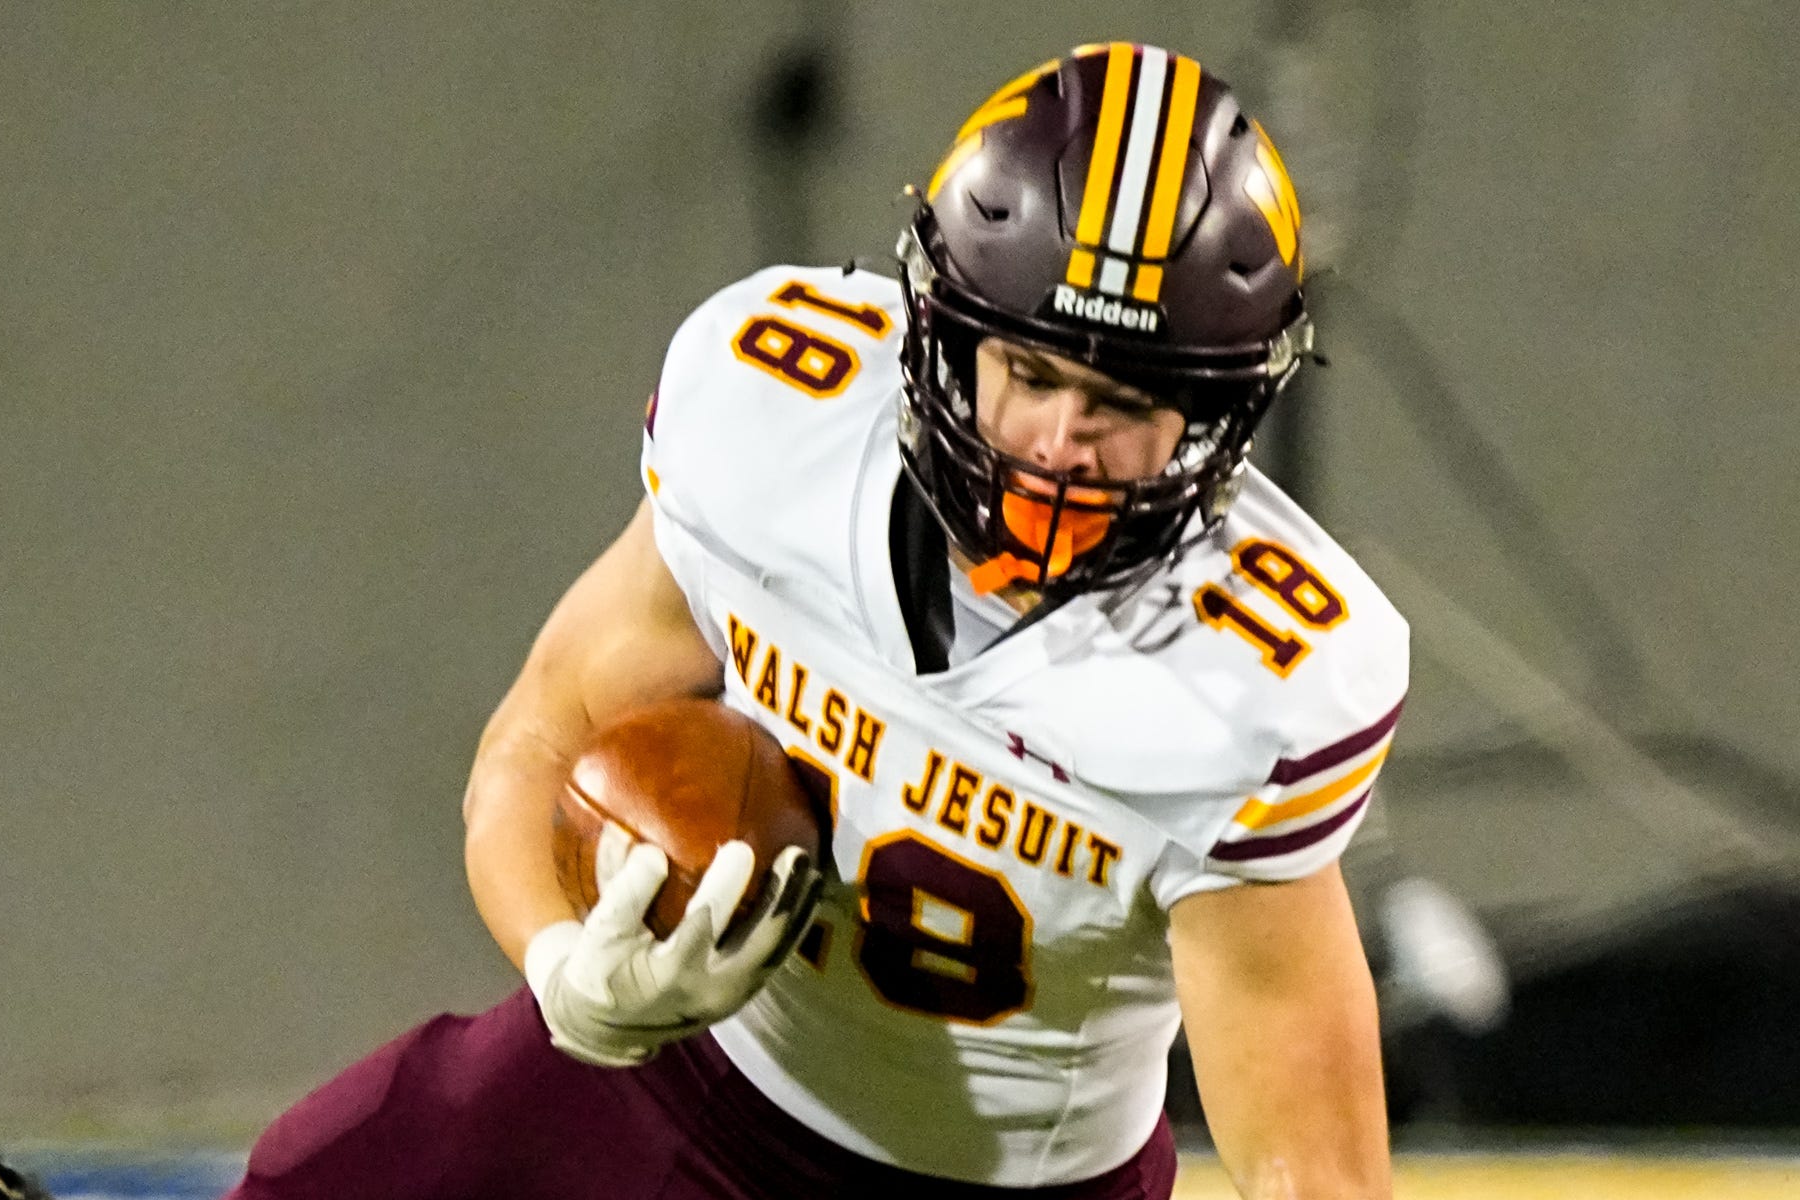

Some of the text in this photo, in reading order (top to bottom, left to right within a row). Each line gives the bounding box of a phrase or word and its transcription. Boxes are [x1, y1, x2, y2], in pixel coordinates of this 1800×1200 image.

[730, 279, 894, 400] 18
[1054, 284, 1158, 332] Riddell
[1191, 537, 1351, 680] 18
[728, 613, 1122, 888] WALSH JESUIT
